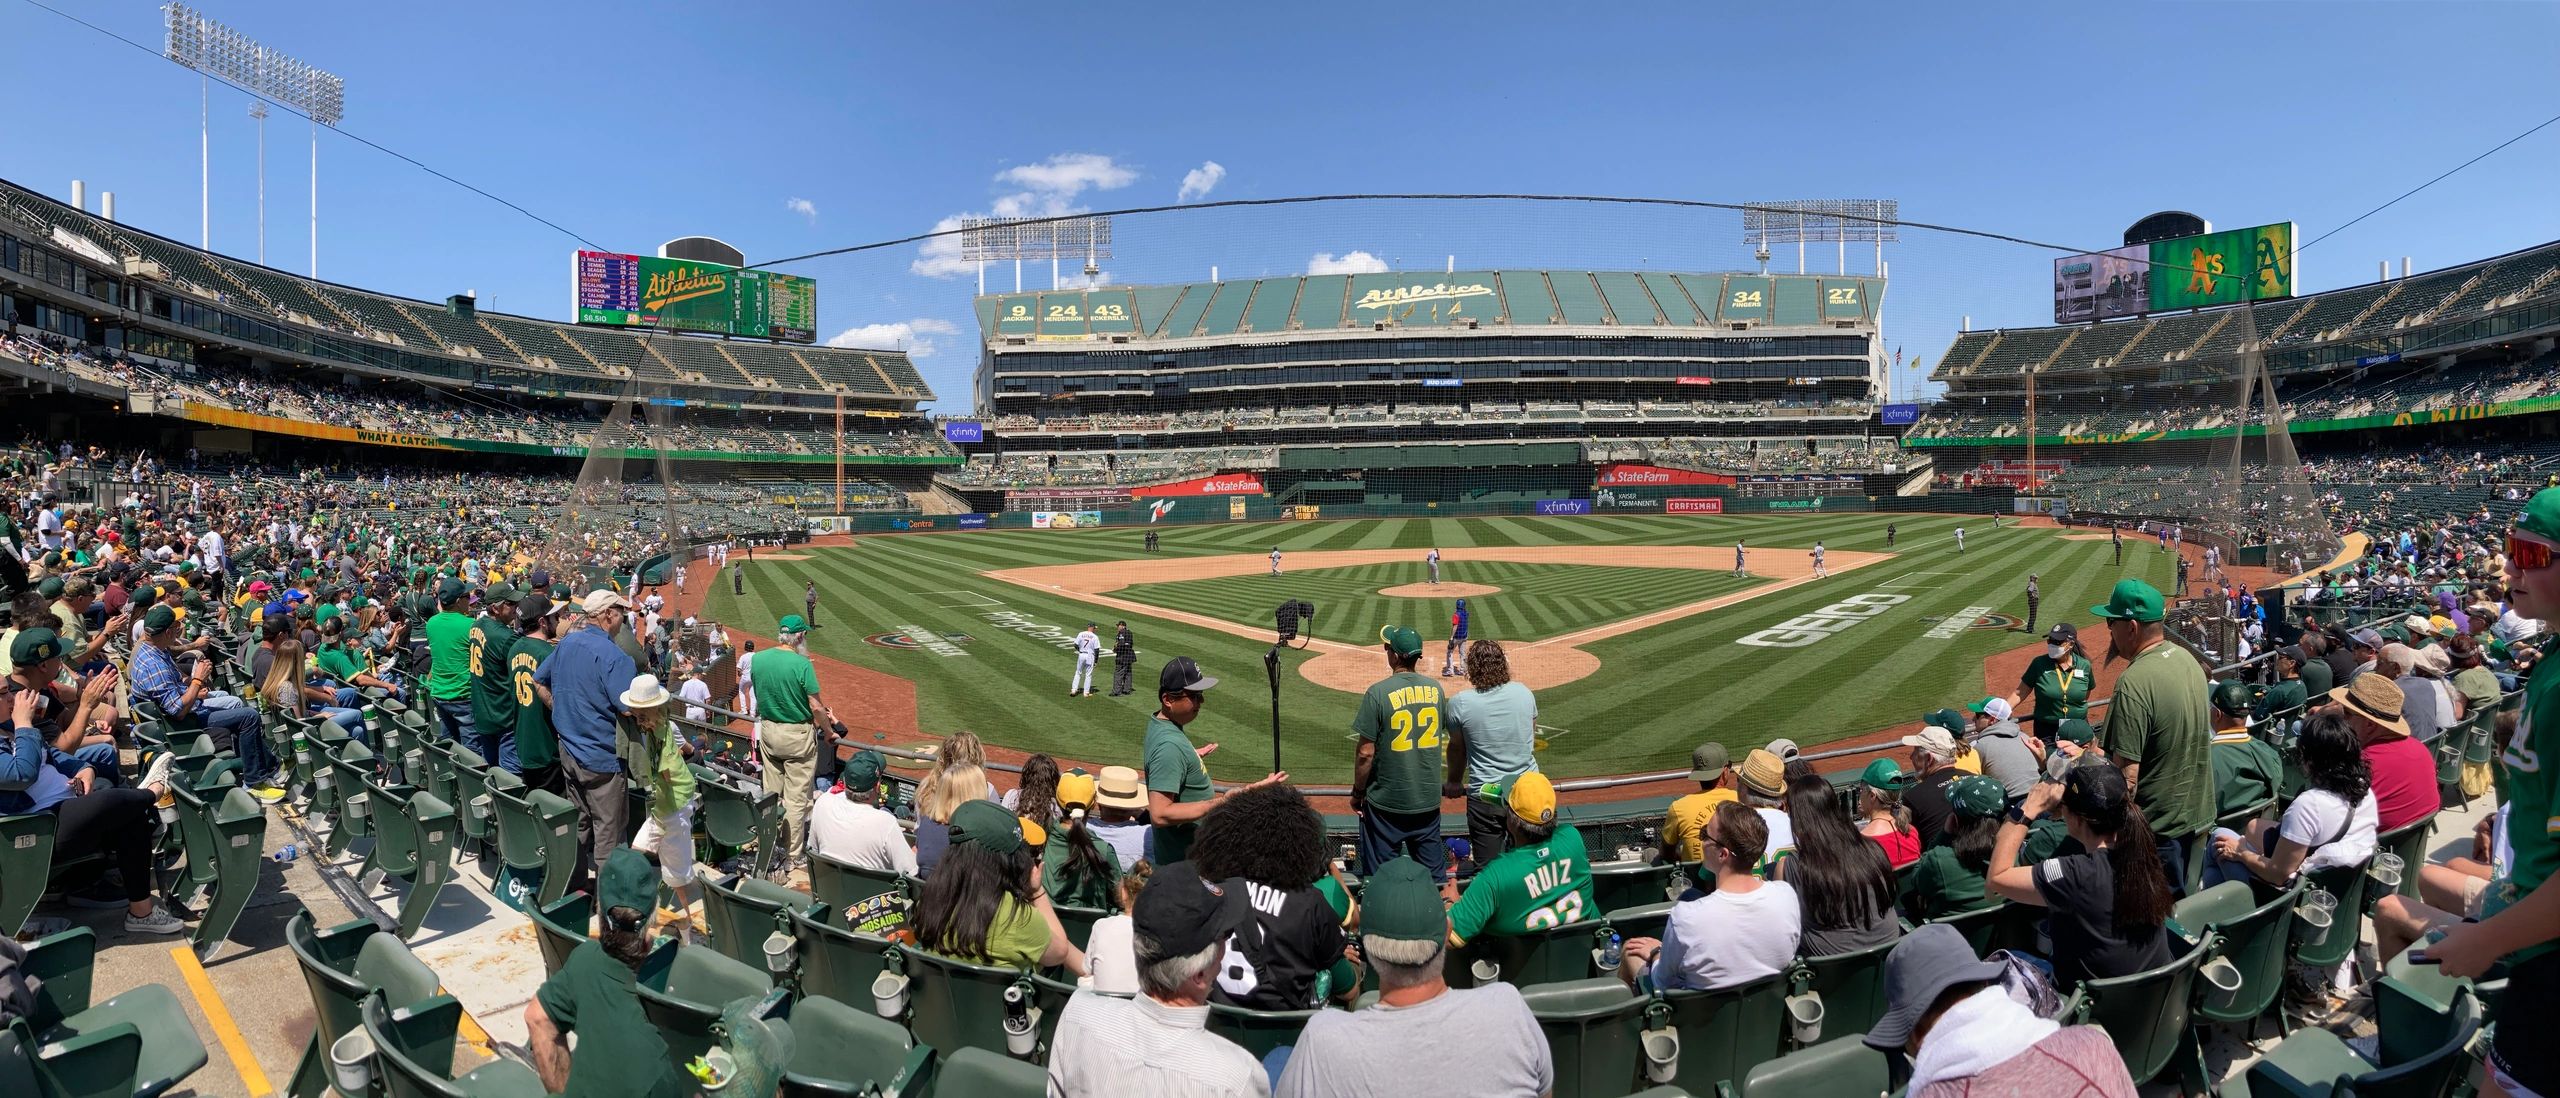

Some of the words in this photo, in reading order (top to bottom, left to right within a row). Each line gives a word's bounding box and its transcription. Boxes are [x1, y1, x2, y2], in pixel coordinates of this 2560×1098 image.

[644, 267, 725, 311] Athletics
[1829, 288, 1856, 299] 27
[1355, 283, 1493, 309] Athletics
[1733, 291, 1762, 302] 34
[1011, 306, 1026, 316] 9
[1050, 306, 1078, 316] 24
[1095, 305, 1123, 316] 43
[1887, 408, 1914, 420] xfinity
[357, 431, 387, 442] WHAT
[390, 435, 398, 443] A
[951, 427, 978, 439] xfinity
[553, 447, 583, 456] WHAT
[1544, 501, 1581, 514] xfinity
[1669, 503, 1717, 511] CRAFTSMAN
[808, 521, 821, 530] Call
[821, 519, 832, 528] 811
[893, 519, 934, 529] RingCentral
[1735, 594, 1912, 648] GEICO
[1084, 639, 1090, 648] 7
[470, 642, 484, 677] 16
[515, 671, 533, 707] 16
[1387, 684, 1439, 710] BYRNES
[1390, 706, 1440, 751] 22
[1693, 811, 1707, 829] LIFE
[20, 835, 32, 847] 18
[1693, 842, 1701, 860] LIVE
[1524, 858, 1571, 899] RUIZ
[1246, 881, 1287, 917] MON
[862, 912, 904, 932] NOSAURS
